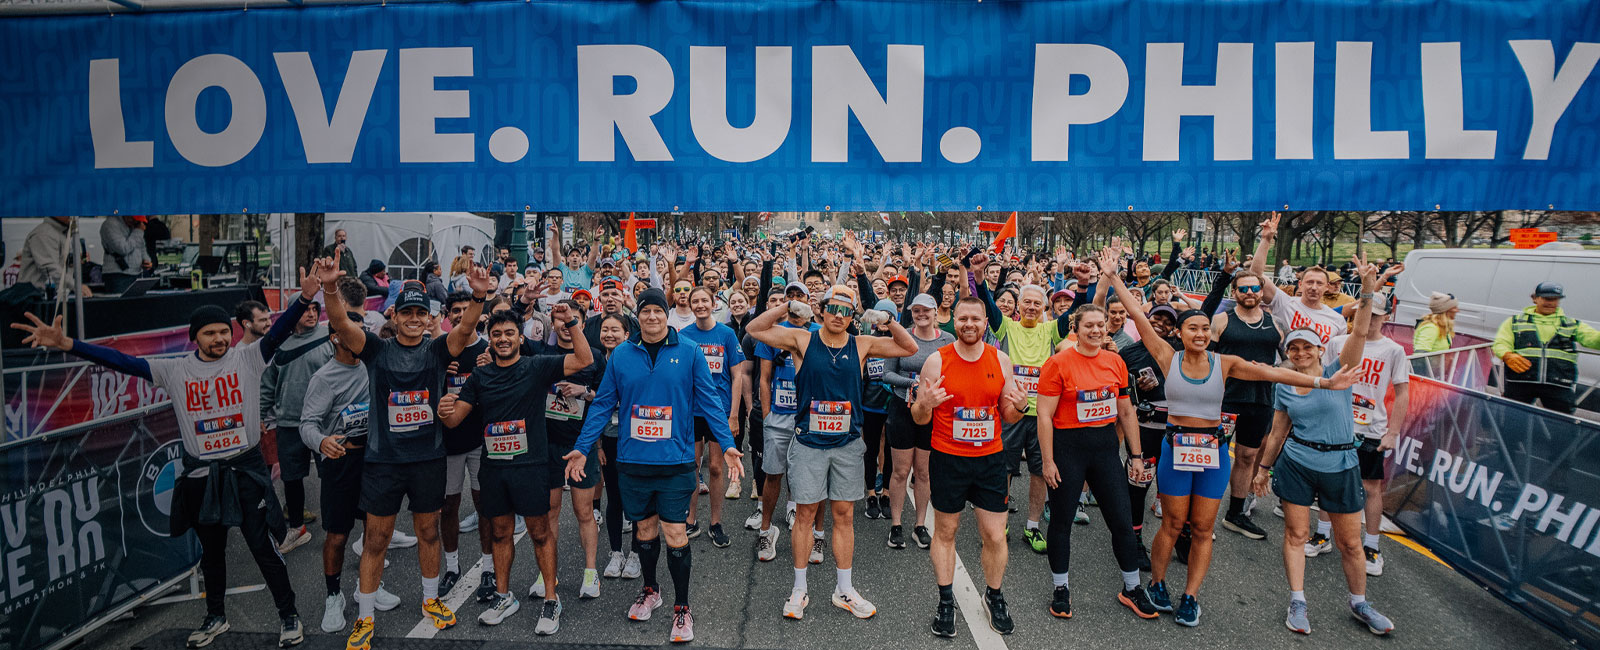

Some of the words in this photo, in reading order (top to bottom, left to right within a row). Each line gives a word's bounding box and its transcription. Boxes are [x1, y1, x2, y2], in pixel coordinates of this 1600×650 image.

[89, 48, 530, 169] LOVE.
[577, 44, 982, 163] RUN.
[1031, 40, 1600, 162] PHILLY
[395, 410, 428, 423] 6896
[1084, 406, 1111, 418] 7229
[637, 426, 664, 436] 6521
[818, 421, 843, 431] 1142
[961, 428, 987, 438] 7125
[204, 435, 241, 451] 6484
[492, 441, 521, 452] 2575
[1180, 453, 1212, 465] 7369
[1428, 449, 1504, 512] RUN.
[43, 476, 105, 583] RUN
[4, 576, 73, 615] MARATHON
[93, 562, 106, 573] 7K
